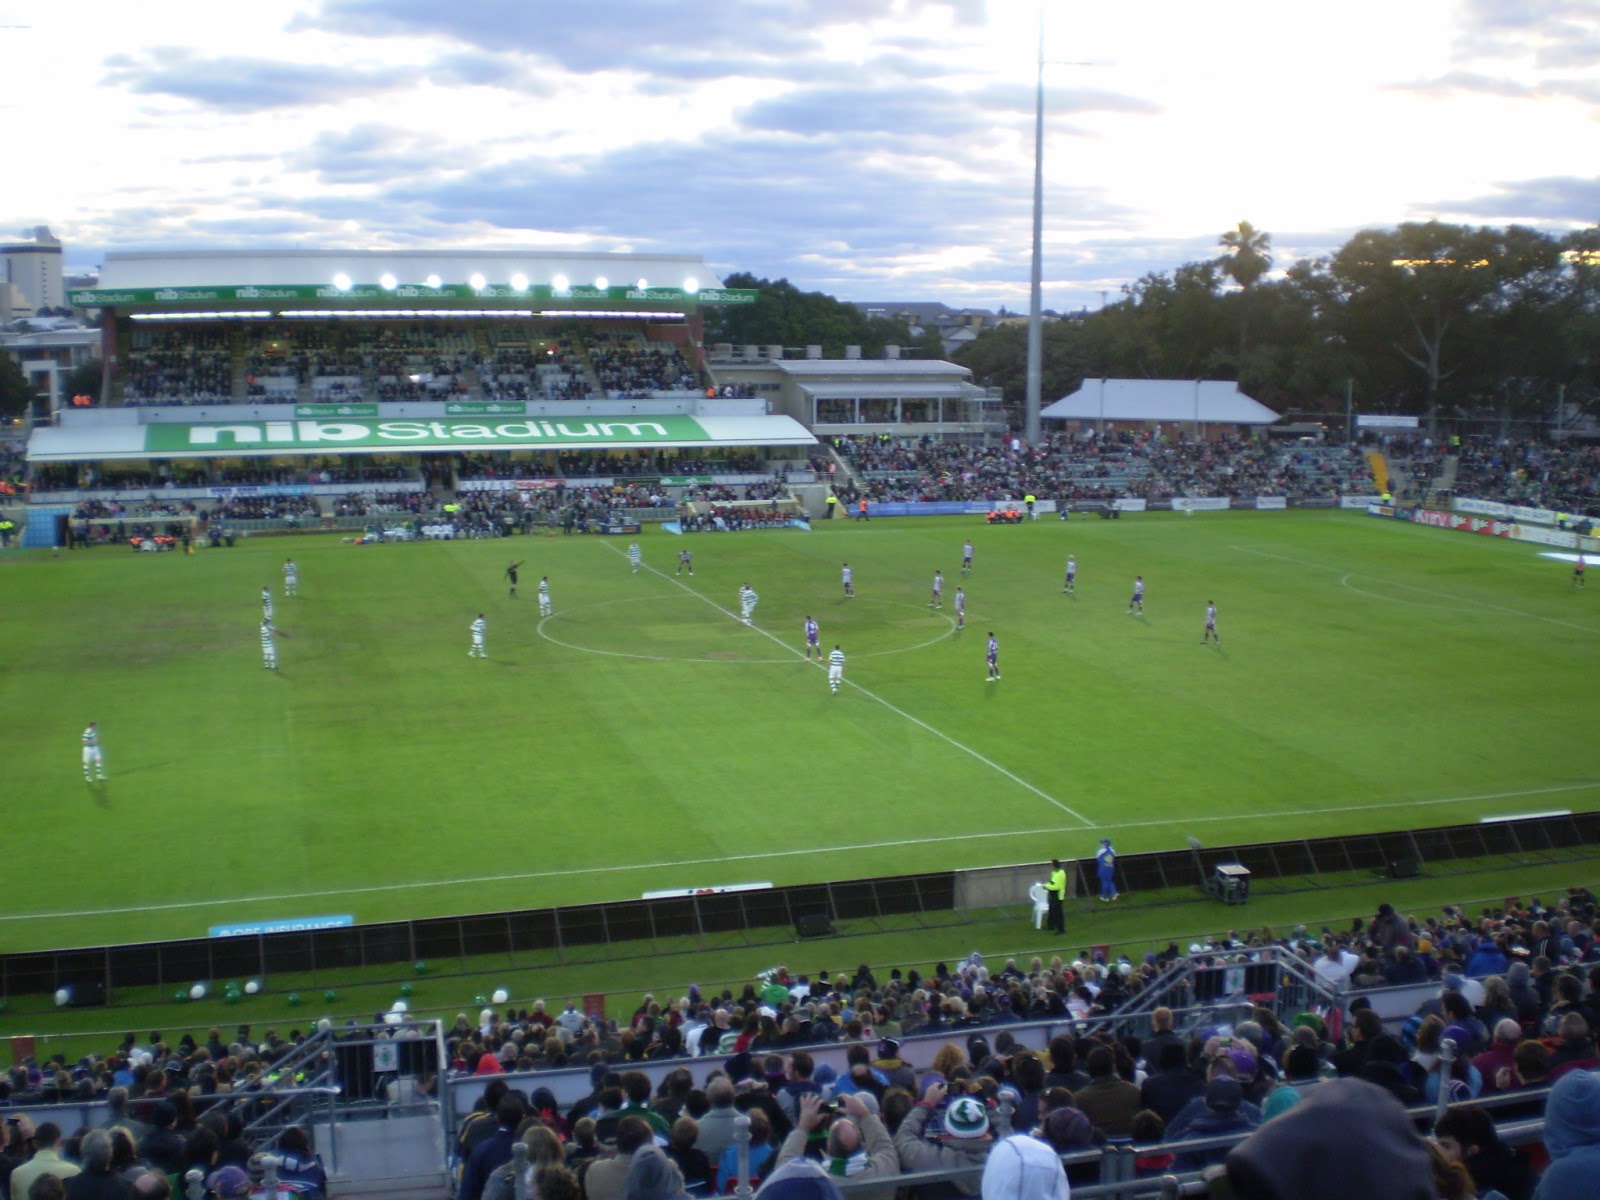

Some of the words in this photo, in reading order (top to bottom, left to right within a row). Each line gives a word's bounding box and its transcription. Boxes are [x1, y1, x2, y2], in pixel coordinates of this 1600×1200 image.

[236, 286, 259, 298] nib
[397, 286, 419, 297] nib
[700, 289, 720, 301] nib
[189, 420, 370, 443] nib
[377, 420, 668, 440] Stadium
